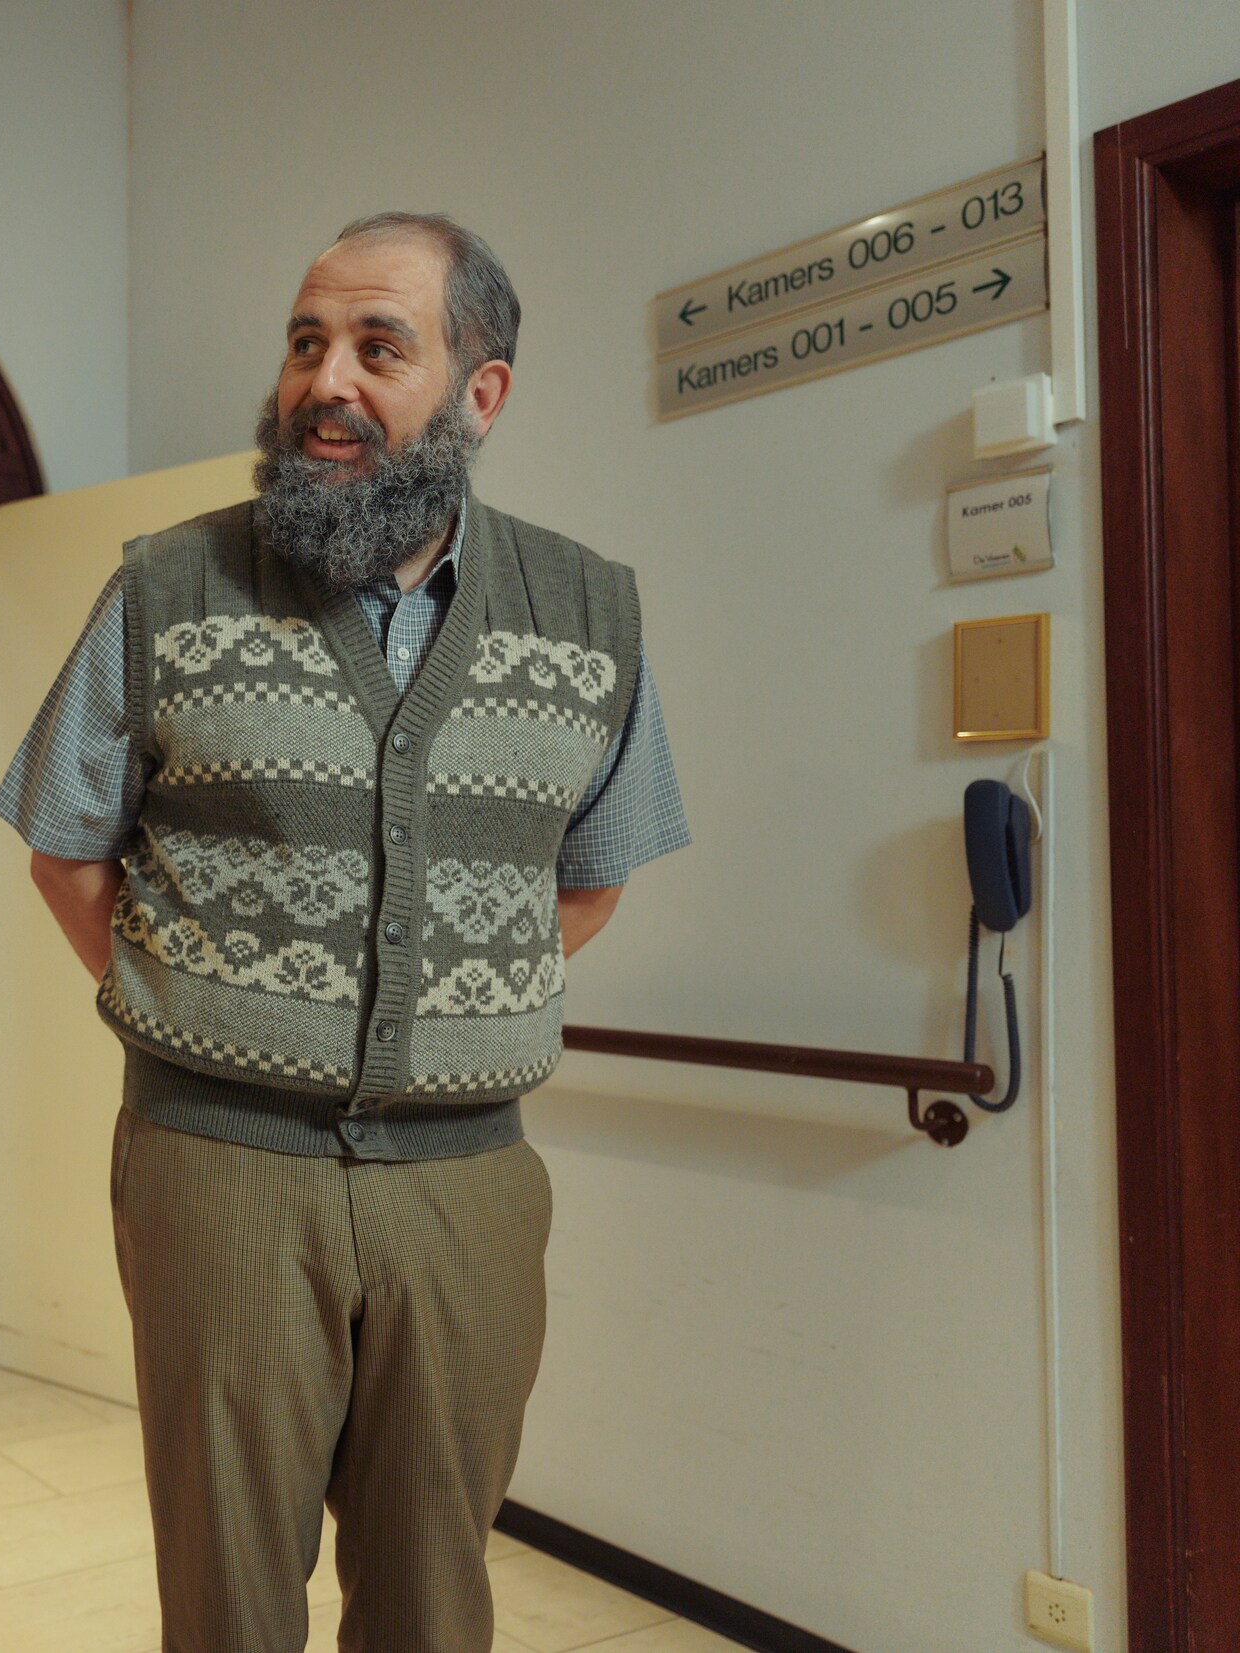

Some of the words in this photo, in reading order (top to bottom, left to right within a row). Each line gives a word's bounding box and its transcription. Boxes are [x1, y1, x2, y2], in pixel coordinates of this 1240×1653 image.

[727, 256, 835, 313] Kamers
[848, 221, 915, 270] 006
[961, 181, 1024, 230] 013
[677, 343, 779, 394] Kamers
[791, 317, 846, 360] 001
[887, 281, 958, 330] 005
[962, 501, 1004, 518] Kamer
[1008, 493, 1032, 508] 005
